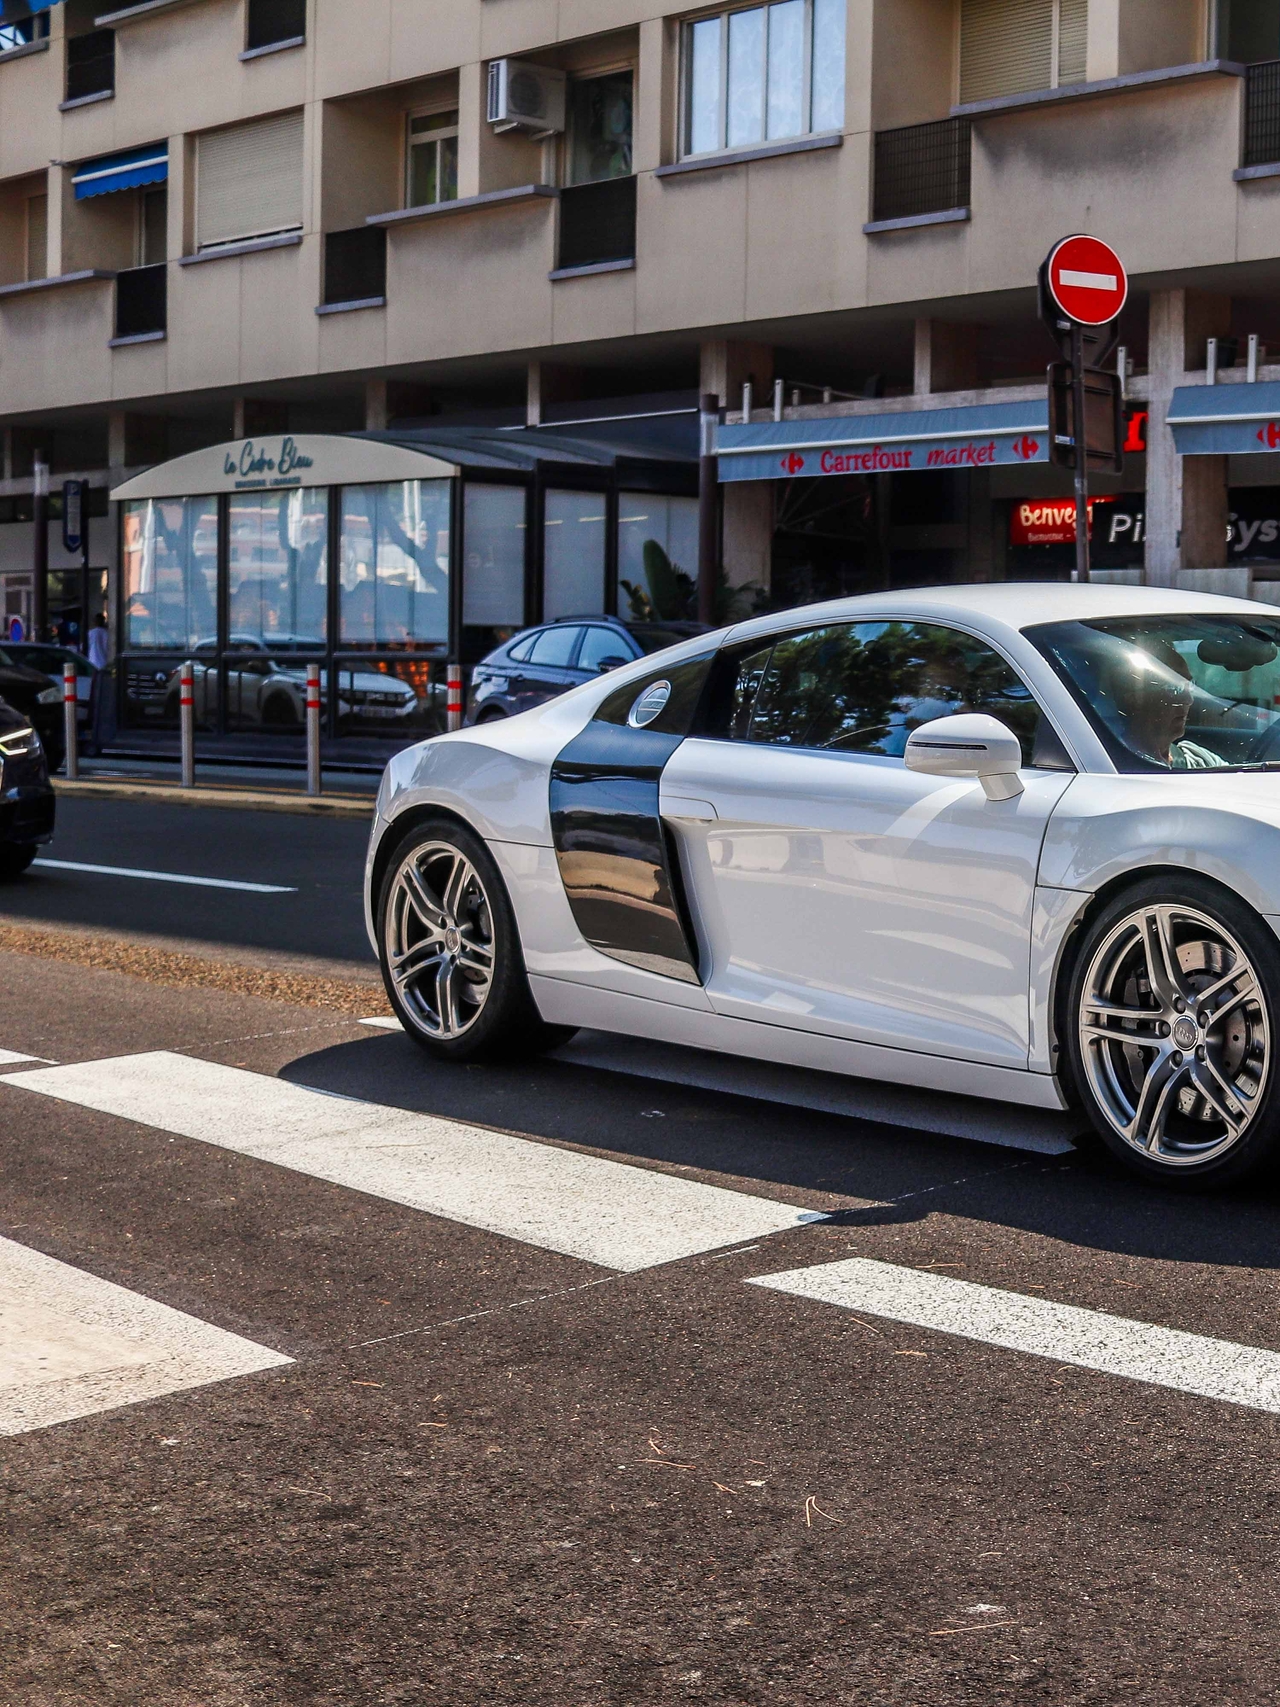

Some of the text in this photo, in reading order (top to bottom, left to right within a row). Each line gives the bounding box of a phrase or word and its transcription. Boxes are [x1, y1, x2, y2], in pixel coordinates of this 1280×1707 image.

[820, 441, 997, 473] Carrefour market
[1108, 513, 1147, 543] Pi
